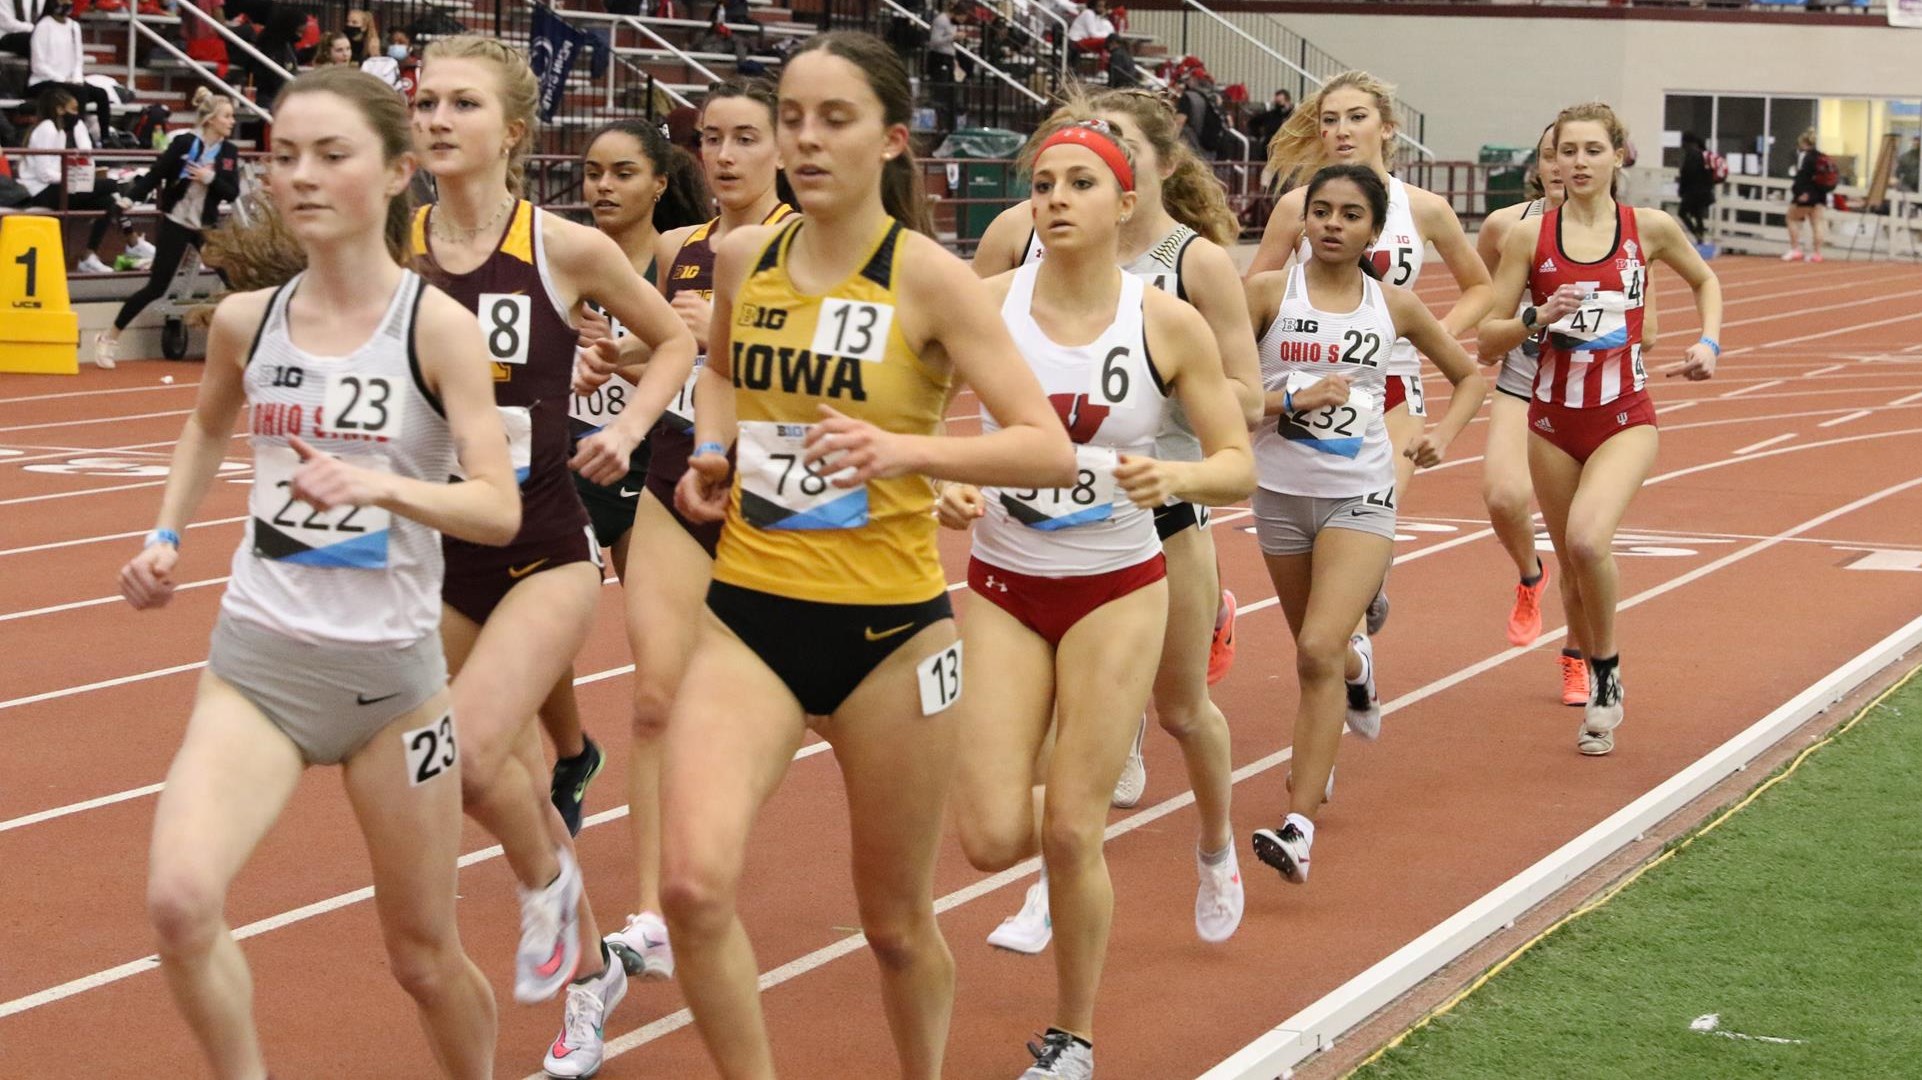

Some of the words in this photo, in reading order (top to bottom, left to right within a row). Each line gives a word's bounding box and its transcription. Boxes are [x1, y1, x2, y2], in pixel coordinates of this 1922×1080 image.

[15, 246, 37, 296] 1
[1393, 247, 1412, 286] 5
[488, 298, 520, 359] 8
[833, 303, 878, 355] 13
[1570, 308, 1603, 333] 47
[732, 341, 868, 402] IOWA
[1280, 341, 1321, 363] OHIO
[1341, 329, 1381, 368] 22
[1101, 346, 1130, 403] 6
[1410, 376, 1424, 414] 5
[335, 376, 391, 431] 23
[769, 453, 827, 496] 78
[931, 648, 959, 706] 13
[410, 714, 456, 783] 23
